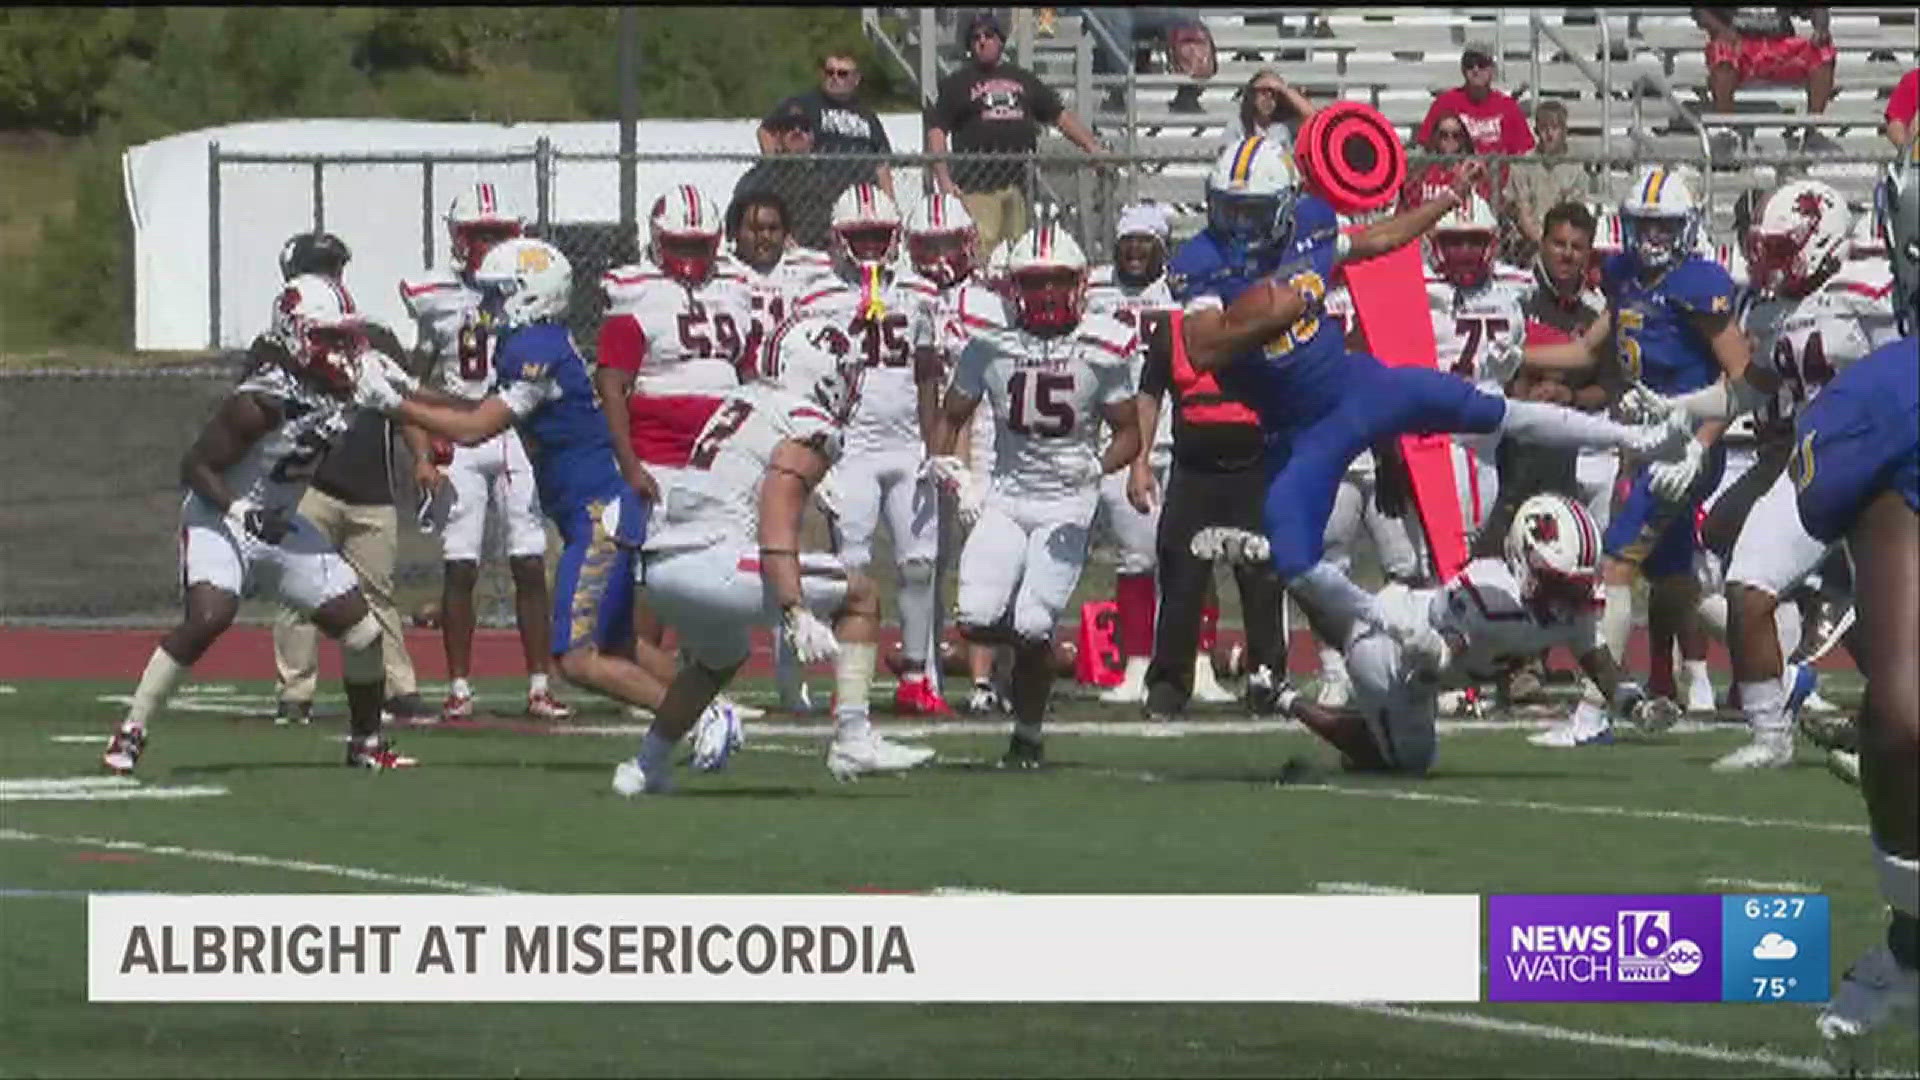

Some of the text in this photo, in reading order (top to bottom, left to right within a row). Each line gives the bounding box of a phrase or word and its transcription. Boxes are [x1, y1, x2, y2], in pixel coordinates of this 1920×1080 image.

[677, 313, 743, 358] 59
[1617, 309, 1645, 380] 5
[688, 398, 753, 471] 2
[1007, 371, 1075, 437] 15
[1095, 611, 1127, 671] 3
